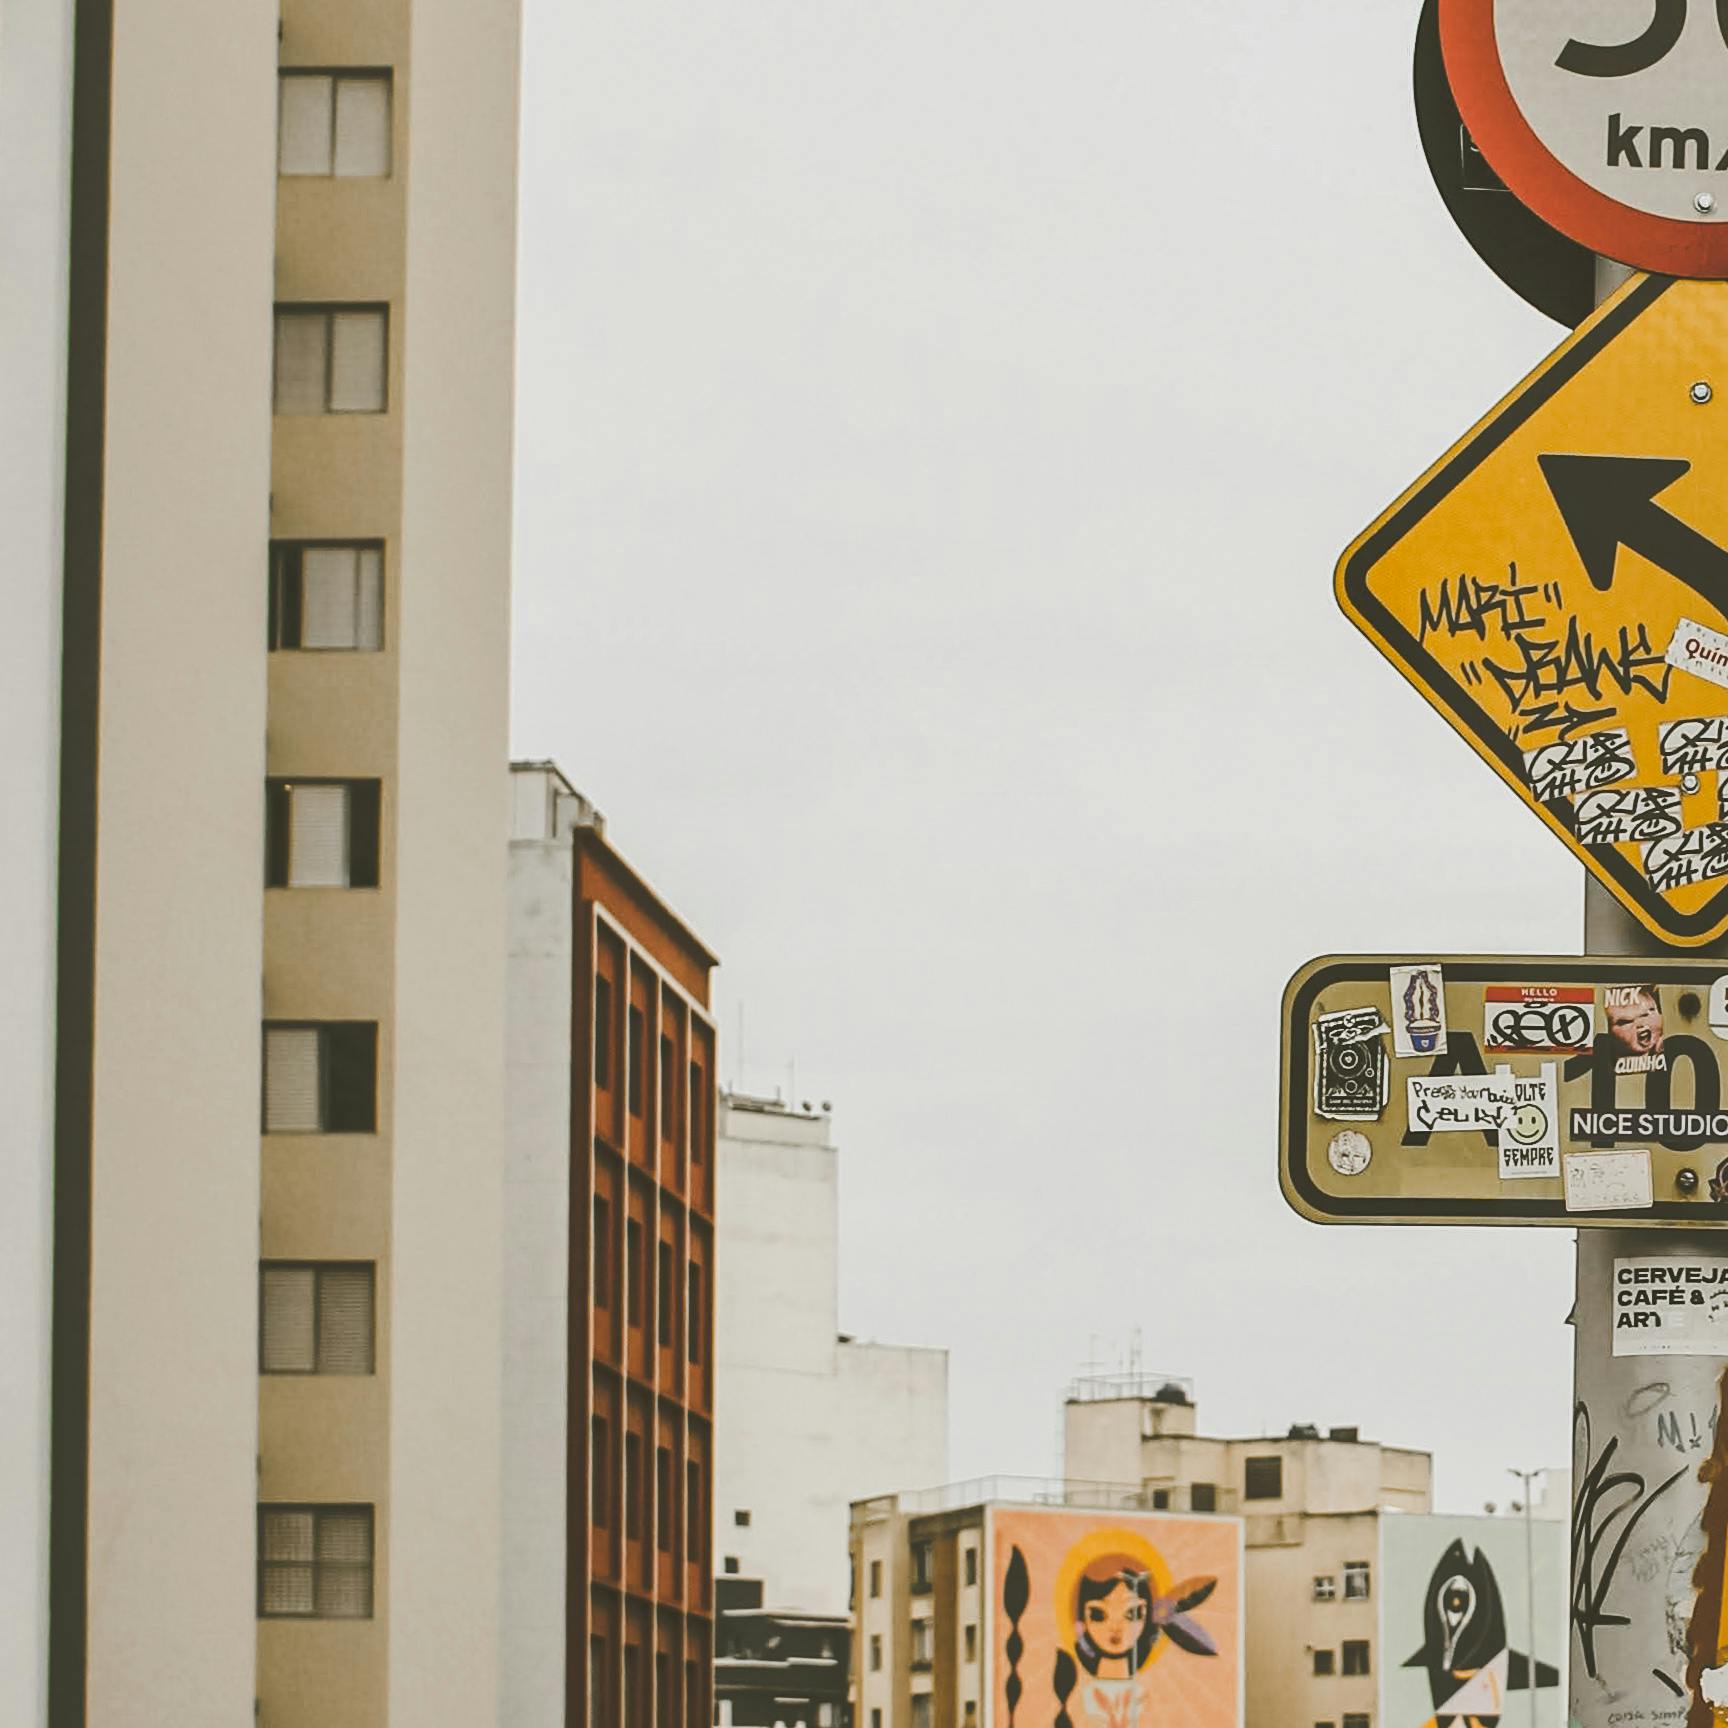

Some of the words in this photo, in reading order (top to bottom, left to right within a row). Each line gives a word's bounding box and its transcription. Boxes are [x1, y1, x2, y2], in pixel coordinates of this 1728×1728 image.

[1521, 988, 1558, 997] HELLO
[1604, 986, 1642, 1008] NICK
[1614, 1054, 1668, 1074] QUINHO
[1514, 1082, 1547, 1102] OLTE
[1572, 1113, 1633, 1135] NICE
[1503, 1146, 1554, 1167] SEMPRE
[1617, 1285, 1686, 1307] CAFÉ
[1689, 1289, 1706, 1306] &
